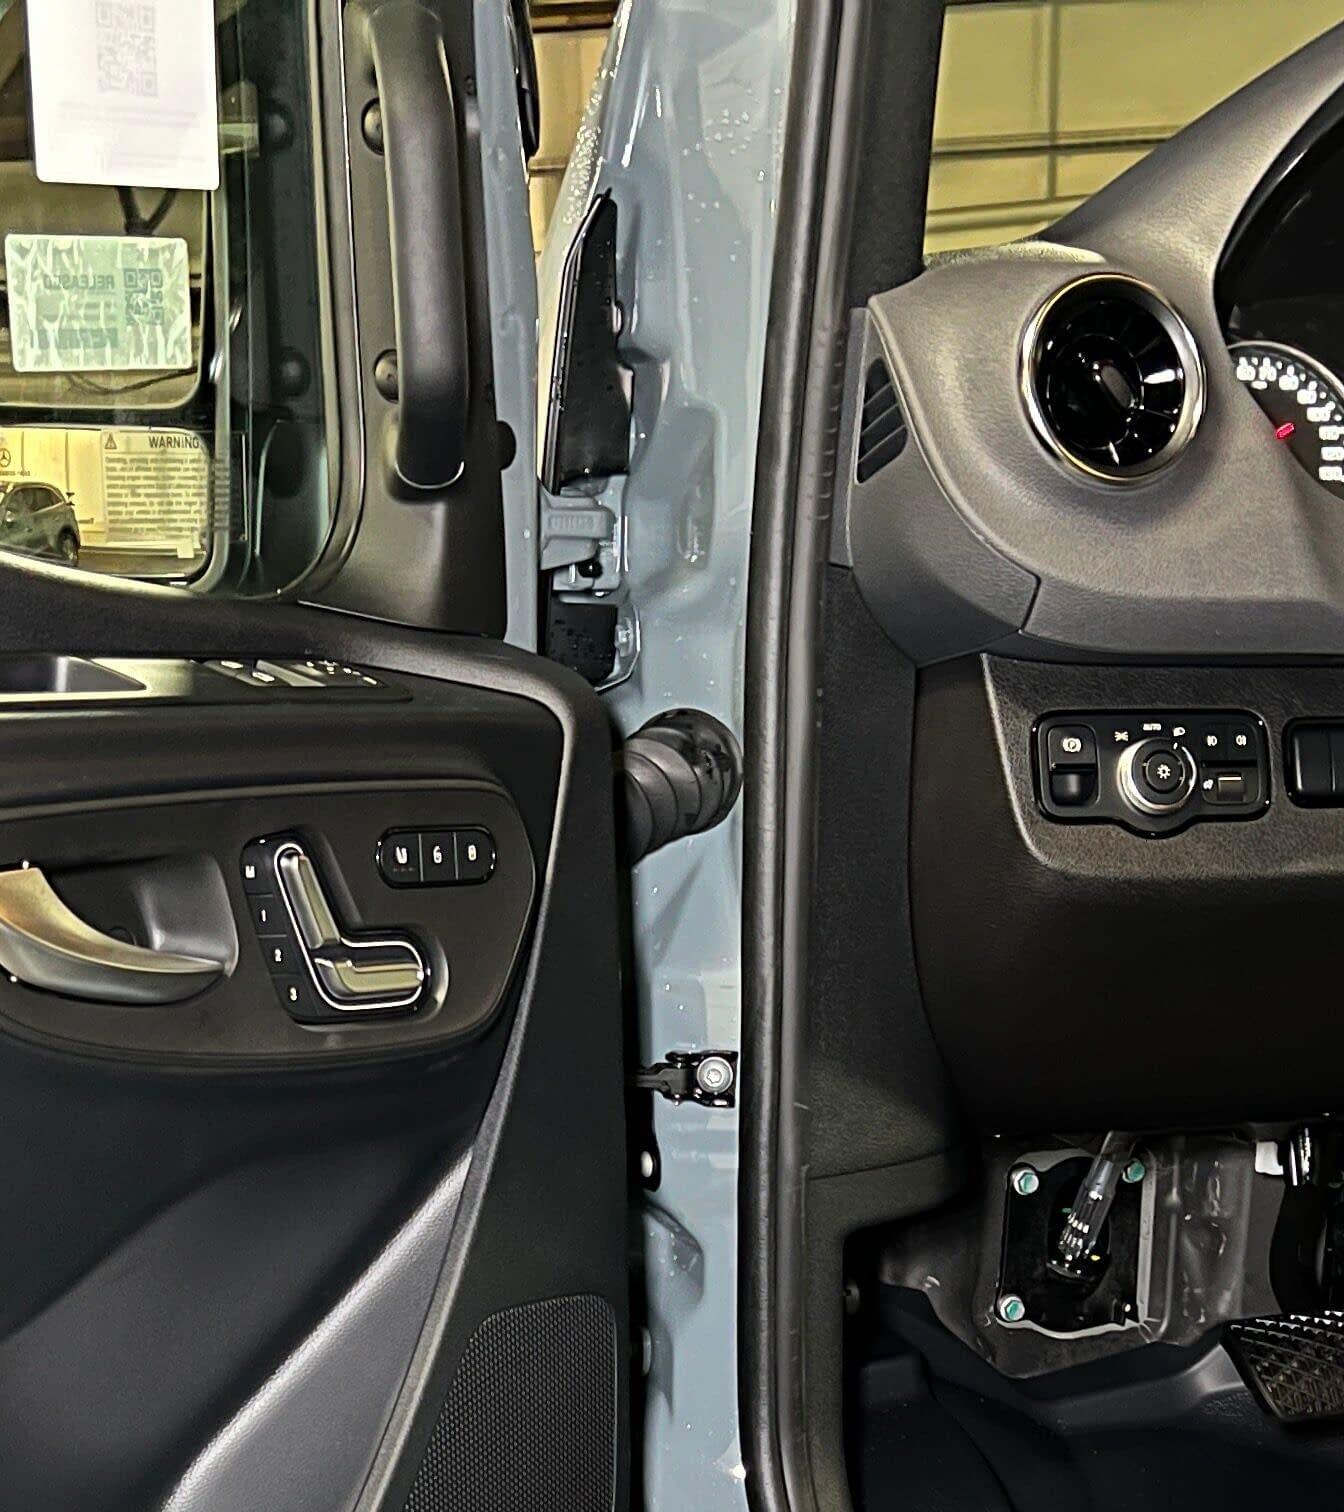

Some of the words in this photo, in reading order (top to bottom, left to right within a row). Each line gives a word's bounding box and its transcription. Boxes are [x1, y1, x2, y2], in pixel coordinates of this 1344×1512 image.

[148, 435, 200, 449] WARNING
[274, 948, 282, 962] 2
[289, 986, 298, 1001] 3
